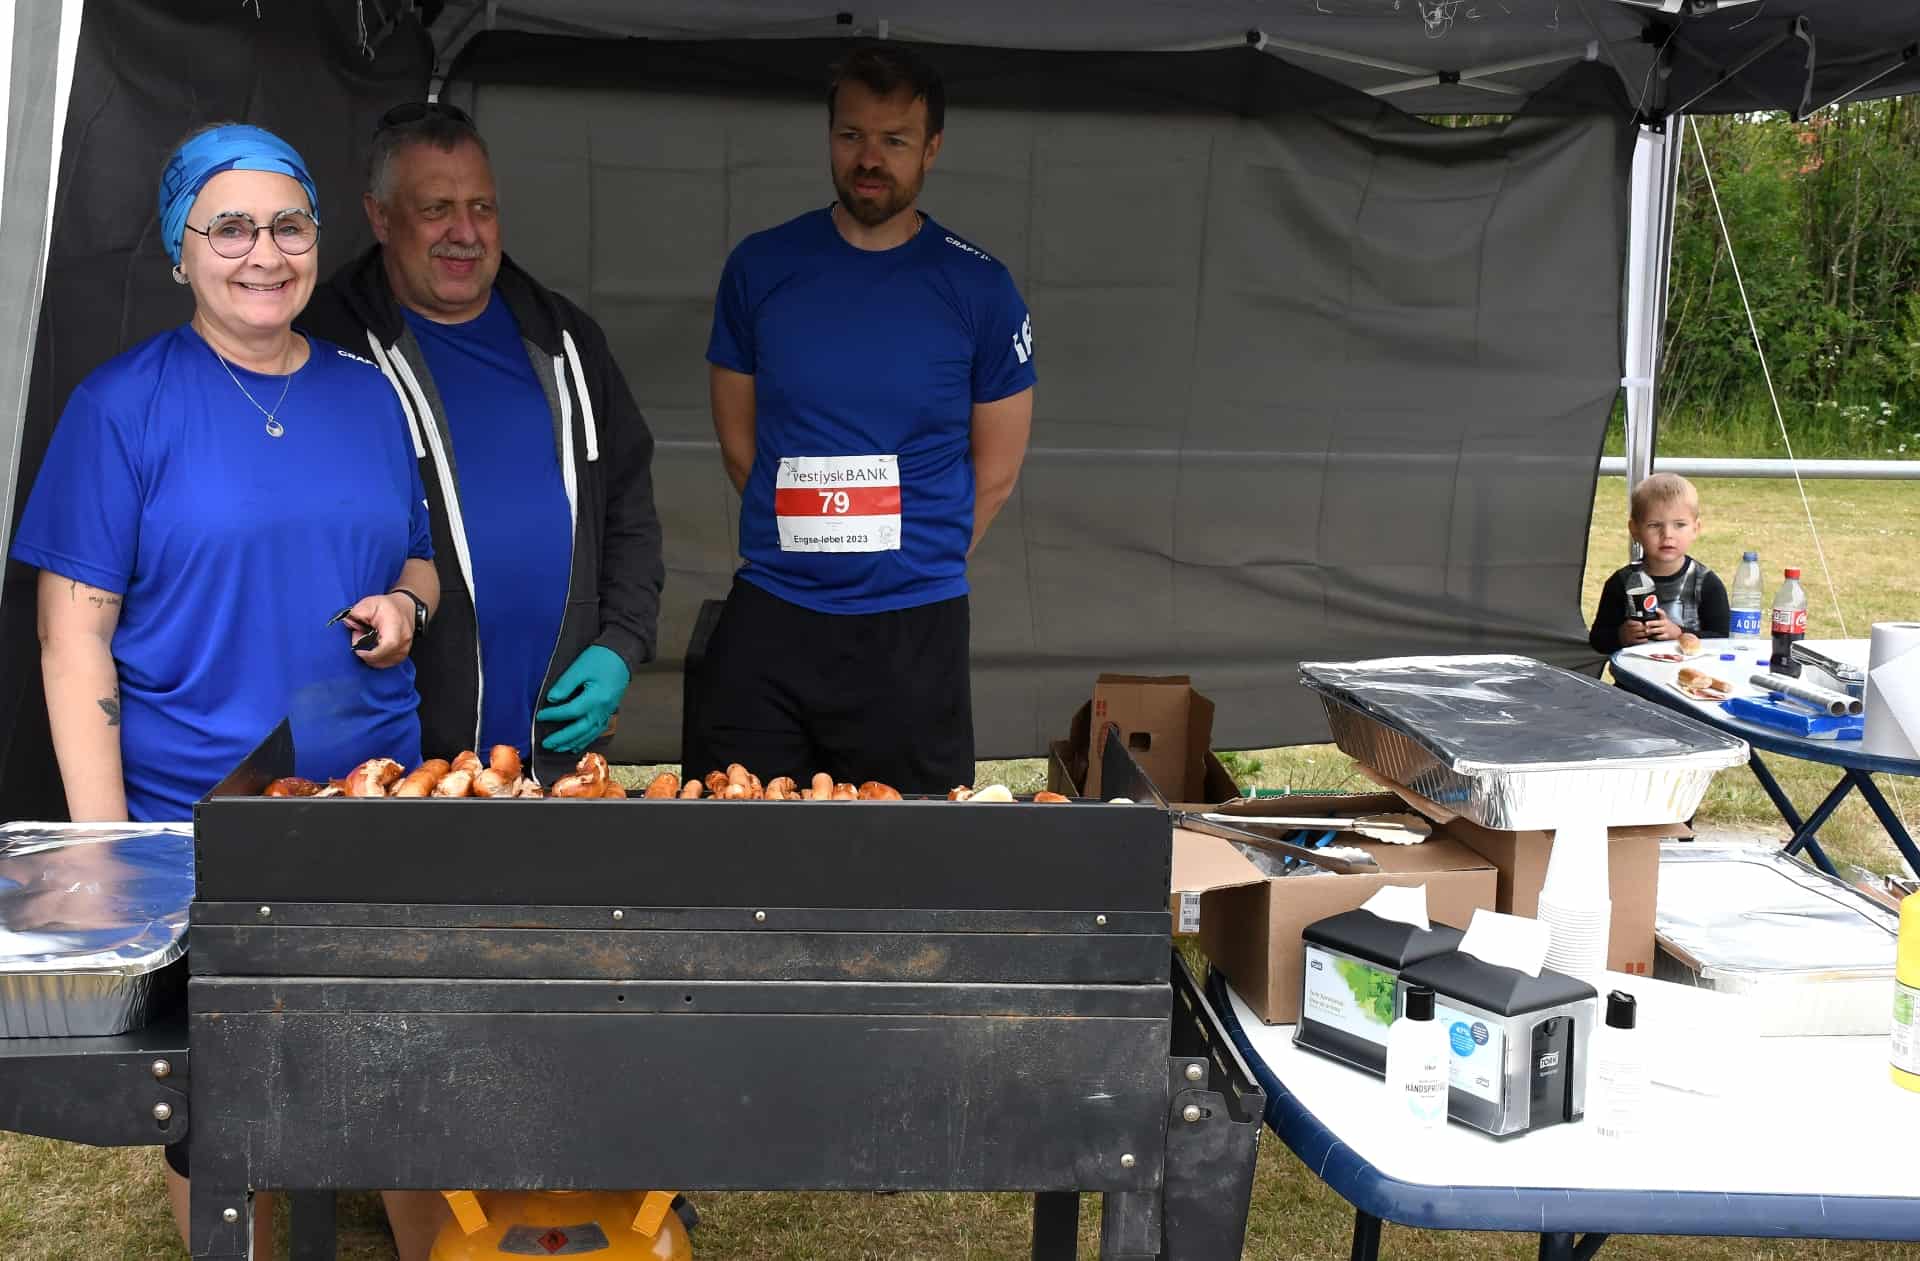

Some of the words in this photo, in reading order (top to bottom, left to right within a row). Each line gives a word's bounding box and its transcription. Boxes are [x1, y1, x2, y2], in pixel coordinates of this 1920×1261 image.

[945, 236, 982, 256] CRAFT
[818, 491, 850, 514] 79
[846, 535, 868, 543] 2023
